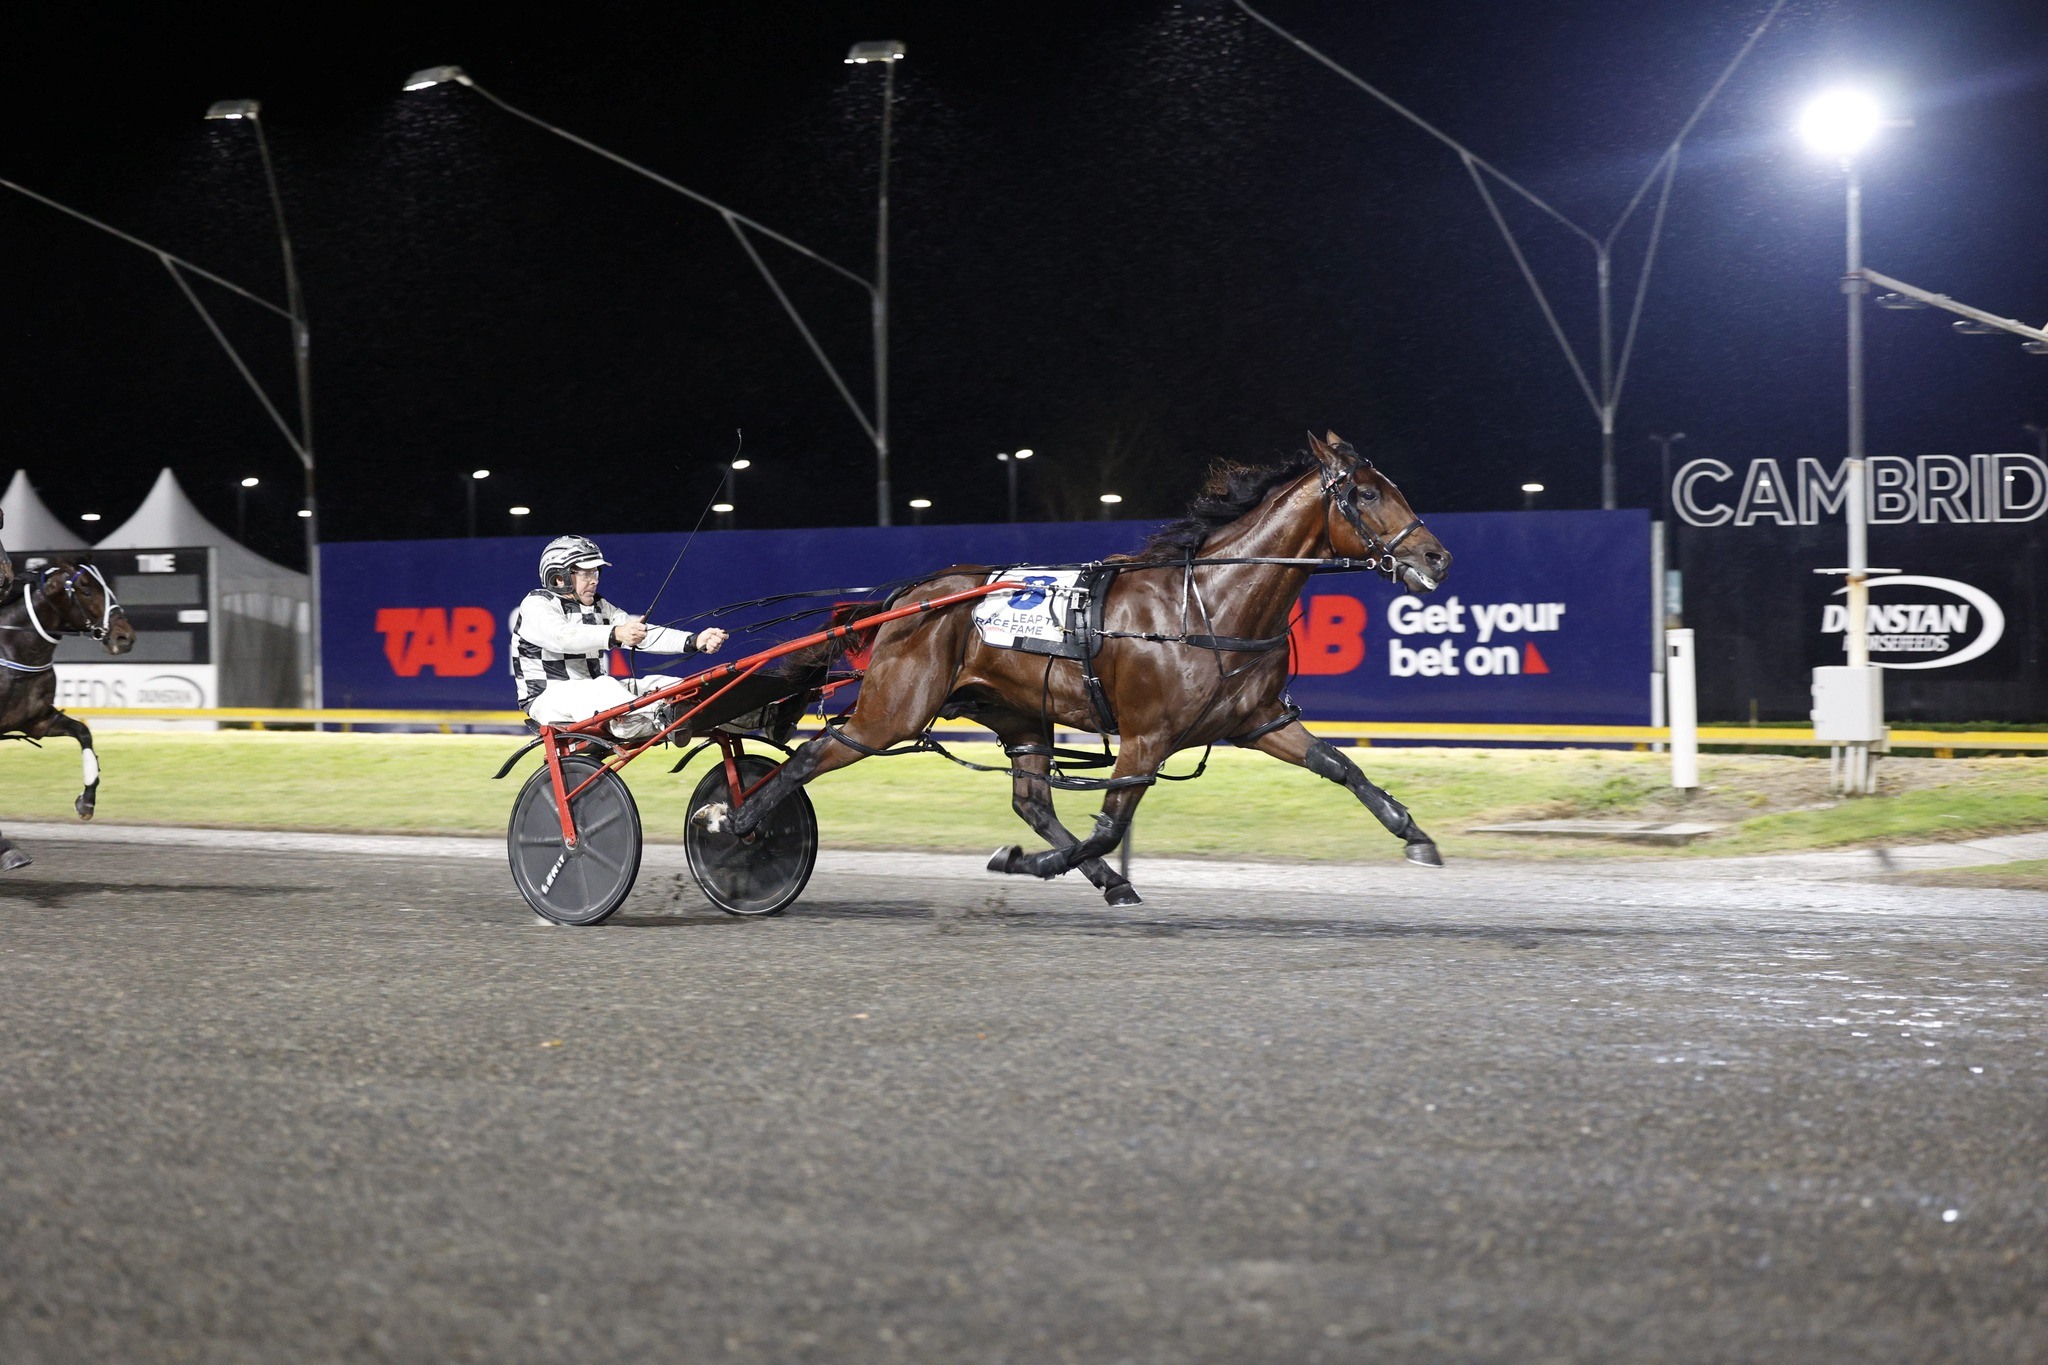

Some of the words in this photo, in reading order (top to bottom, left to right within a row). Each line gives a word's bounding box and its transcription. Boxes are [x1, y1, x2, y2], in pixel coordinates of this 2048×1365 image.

[1671, 453, 2048, 526] CAMBRID
[1007, 575, 1057, 611] 8
[976, 616, 1010, 628] RACE
[1010, 625, 1043, 636] FAME
[1012, 613, 1043, 624] LEAP
[1287, 594, 1367, 676] AB
[1387, 595, 1466, 635] Get
[1470, 602, 1566, 643] your
[1820, 604, 1970, 633] DNSTAN
[375, 606, 496, 677] TAB
[1389, 639, 1459, 677] bet
[1464, 645, 1520, 677] on
